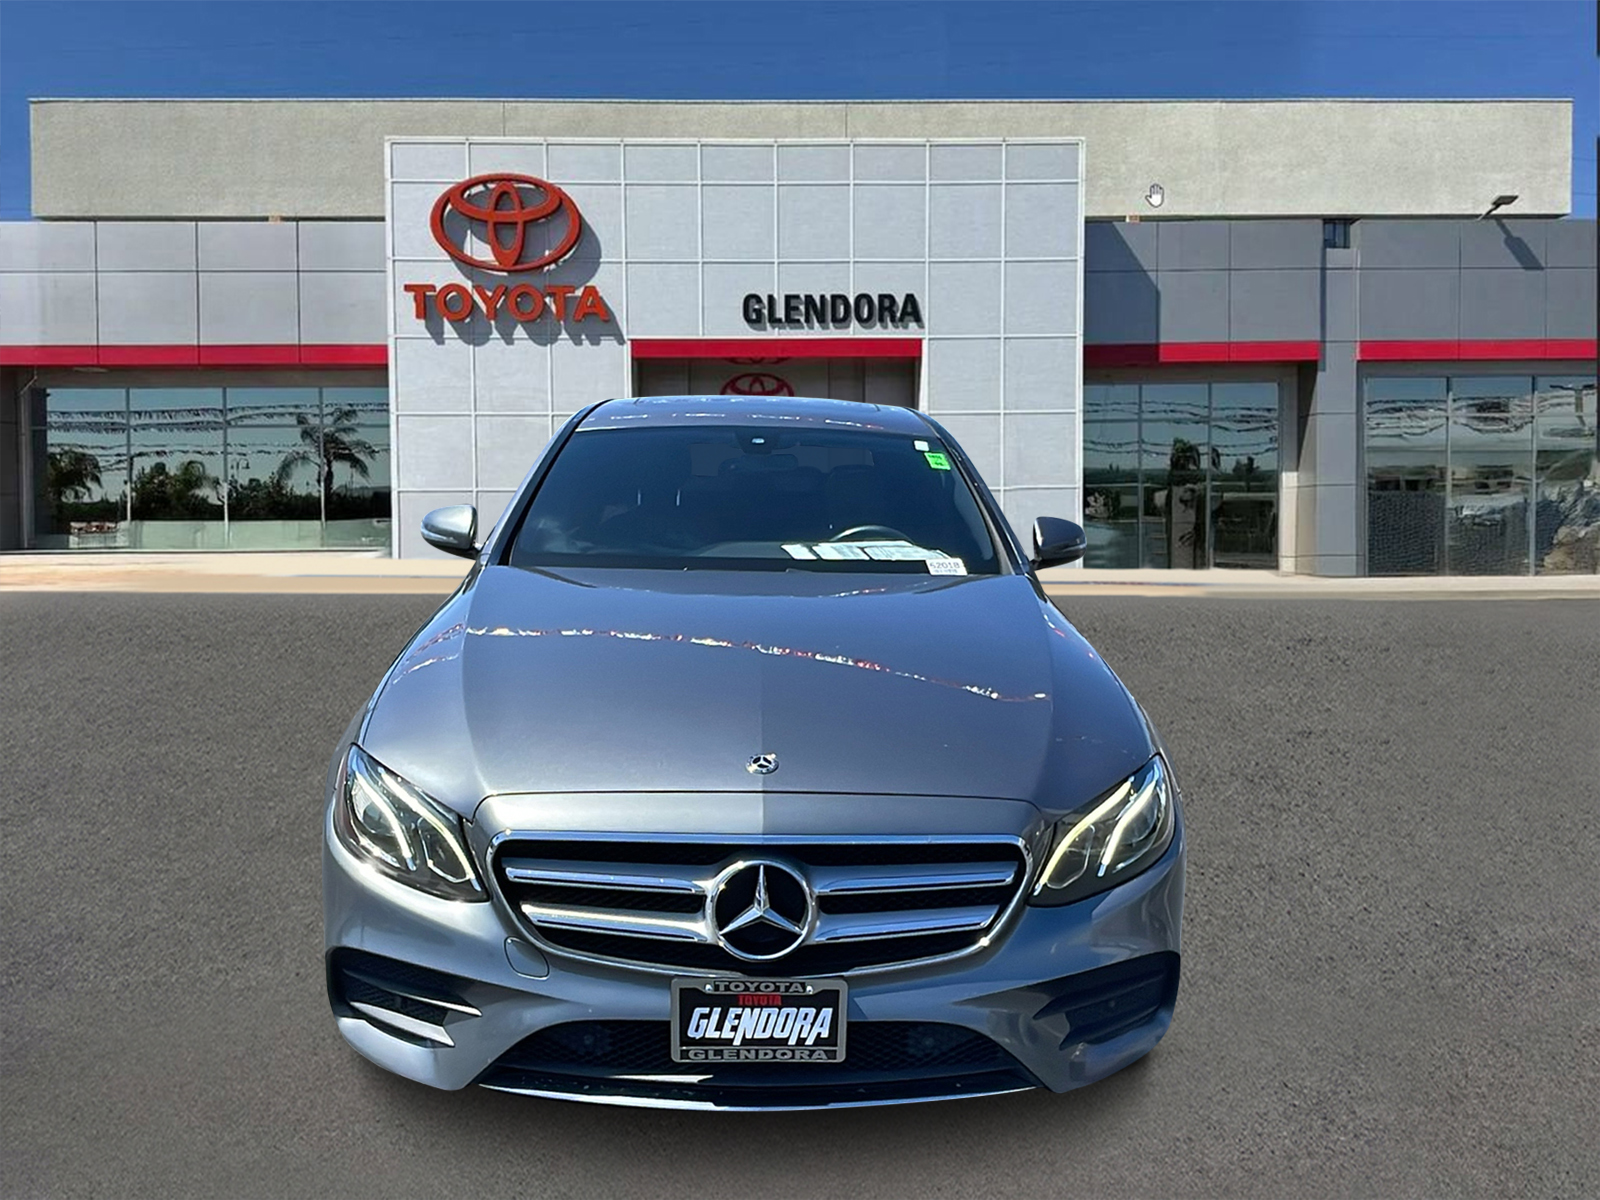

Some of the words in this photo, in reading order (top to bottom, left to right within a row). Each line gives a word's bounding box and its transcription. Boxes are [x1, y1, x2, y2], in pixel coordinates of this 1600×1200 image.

[404, 283, 610, 321] TOYOTA
[742, 293, 922, 325] GLENDORA
[715, 981, 804, 992] TOYOTA
[738, 994, 782, 1006] TOYOTA
[687, 1007, 833, 1046] GLENDORA
[688, 1050, 828, 1061] GLENDORA
